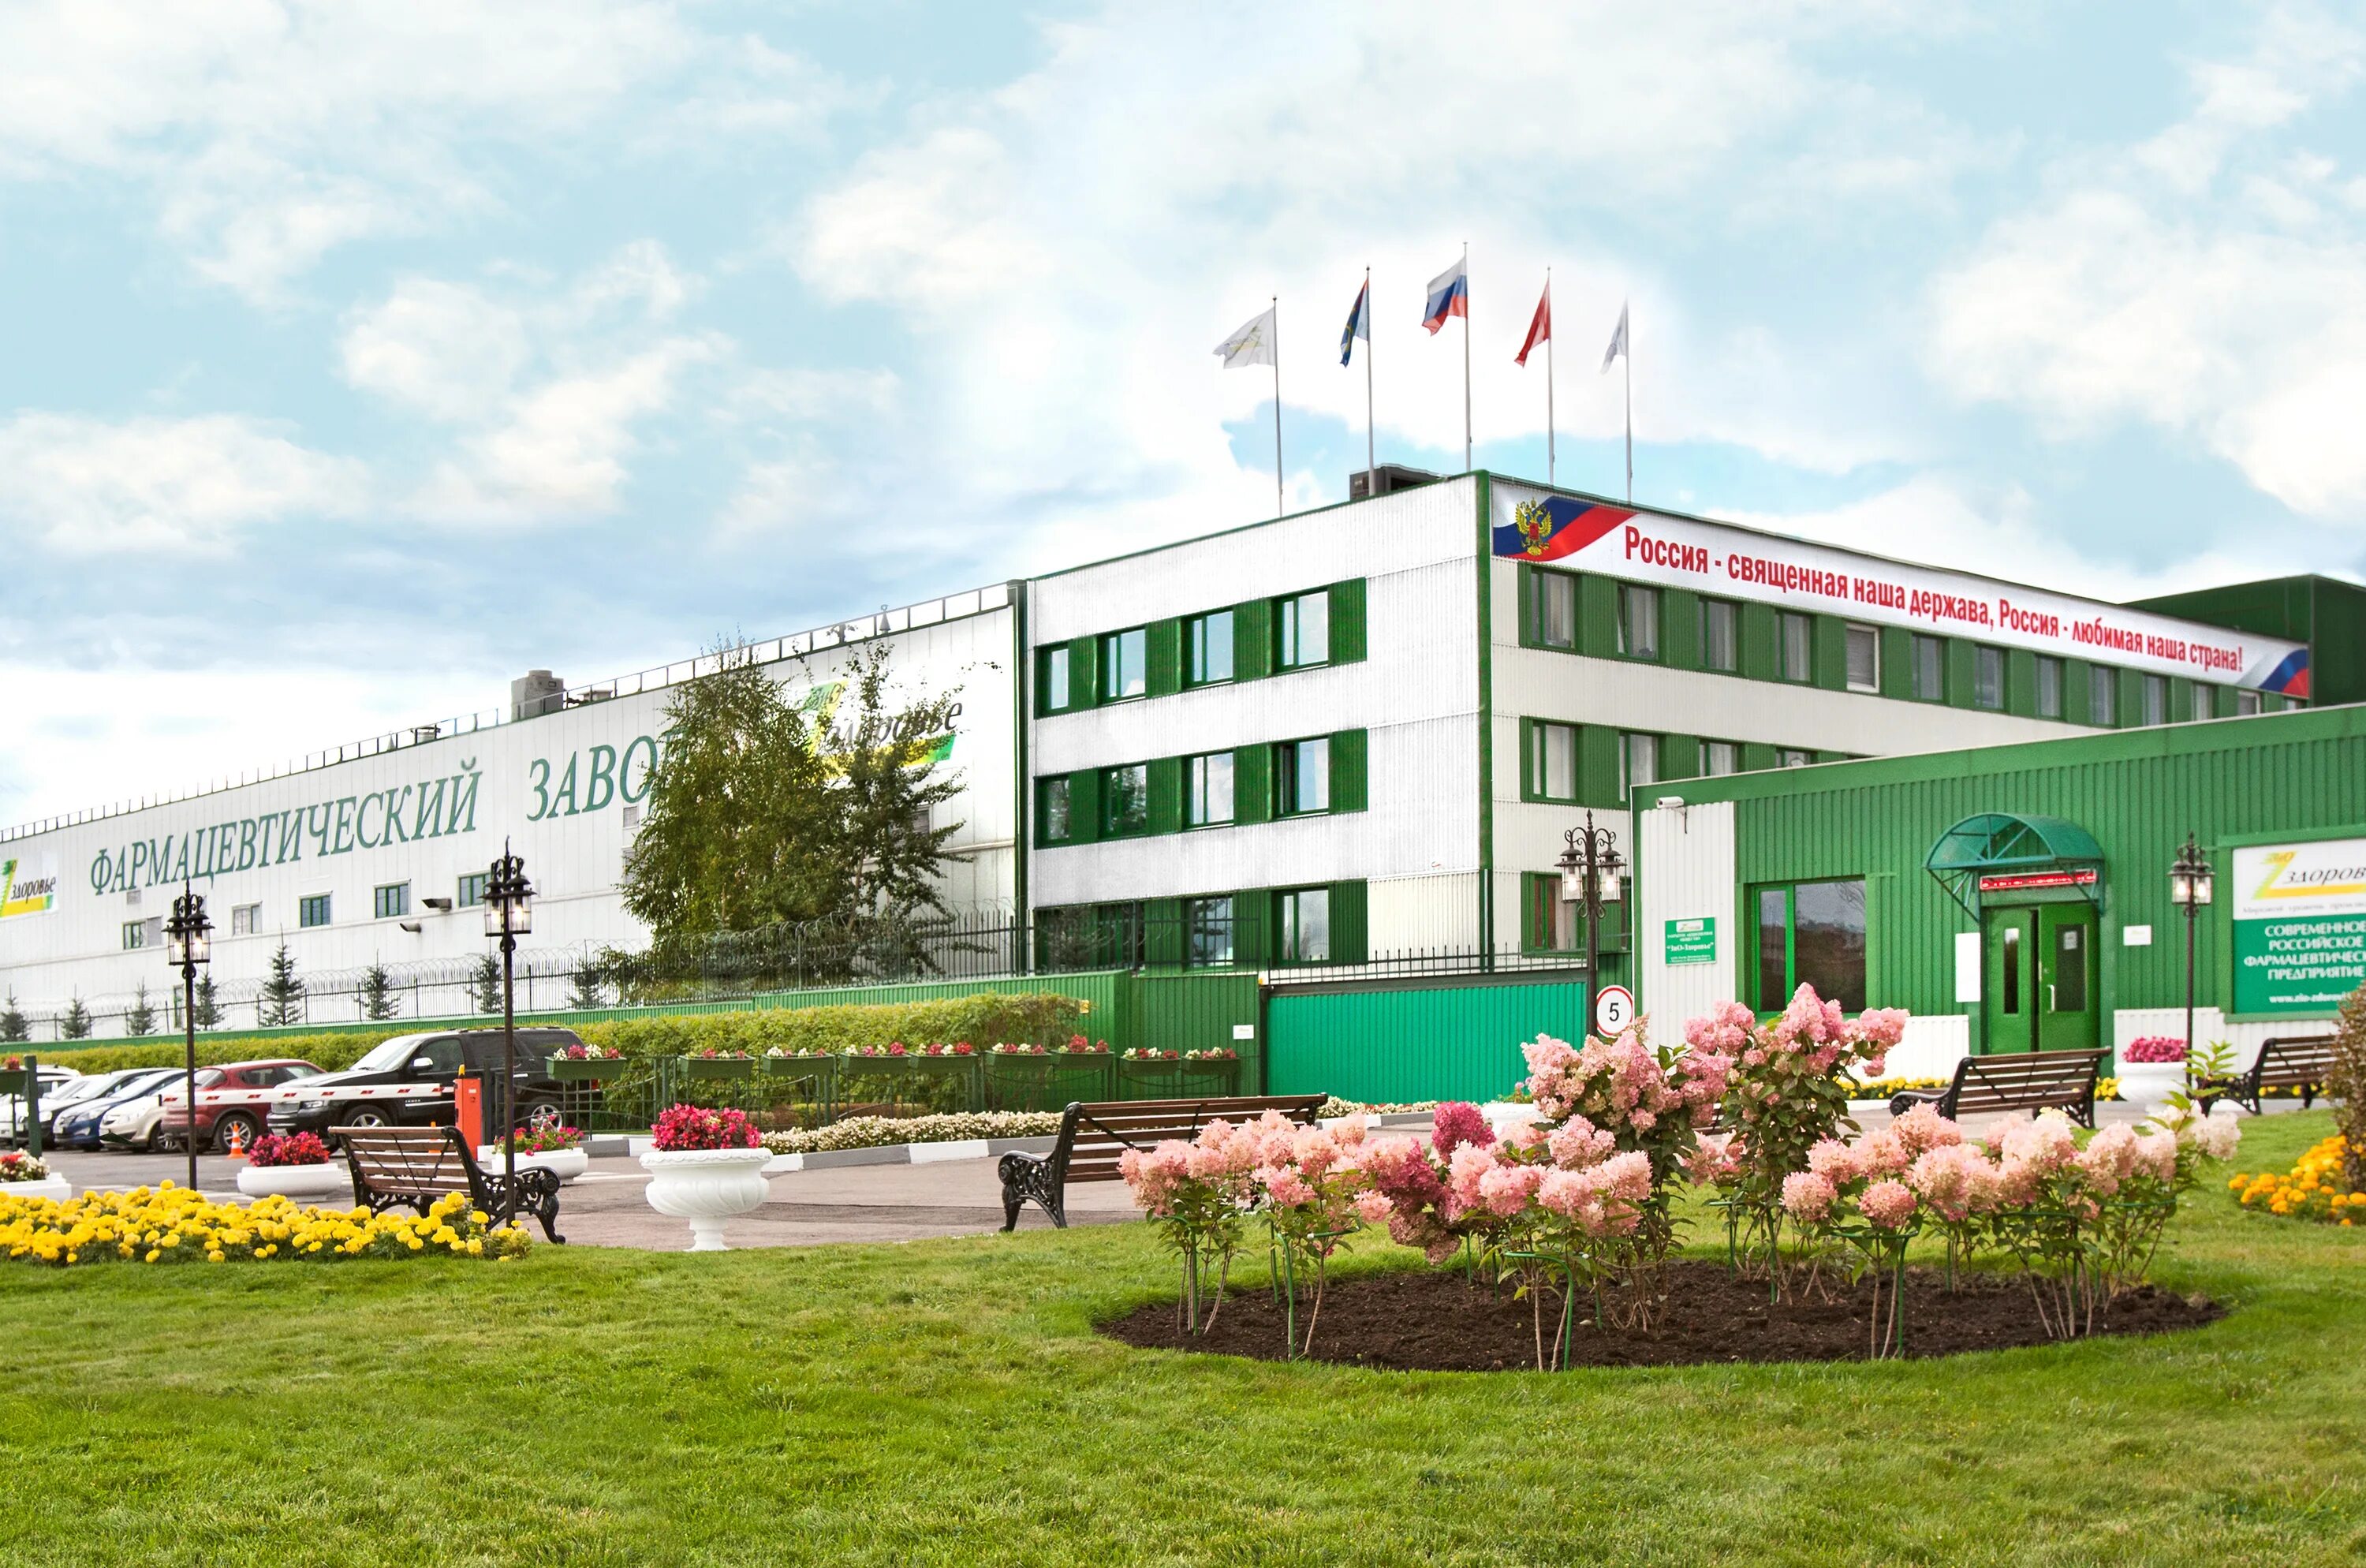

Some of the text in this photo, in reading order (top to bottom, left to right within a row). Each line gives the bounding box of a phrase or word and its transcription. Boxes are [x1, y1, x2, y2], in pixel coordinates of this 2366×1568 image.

[1625, 525, 1708, 574] Россия
[1727, 554, 1848, 599] священная
[1853, 577, 1906, 610] наша
[1909, 588, 1995, 632] держава,
[1998, 599, 2059, 638] Россия
[2072, 617, 2143, 654] любимая
[2146, 635, 2187, 663] наша
[2189, 644, 2244, 672] страна!
[91, 756, 483, 896] ФАРМАЦЕВТИЧЕСКИЙ
[2264, 920, 2366, 938] СОВРЕМЕННОЕ
[2268, 935, 2364, 951] РОССИЙСКОЕ
[2267, 965, 2366, 980] ПРЕДПРИЯТИЕ
[1609, 1002, 1619, 1021] 5
